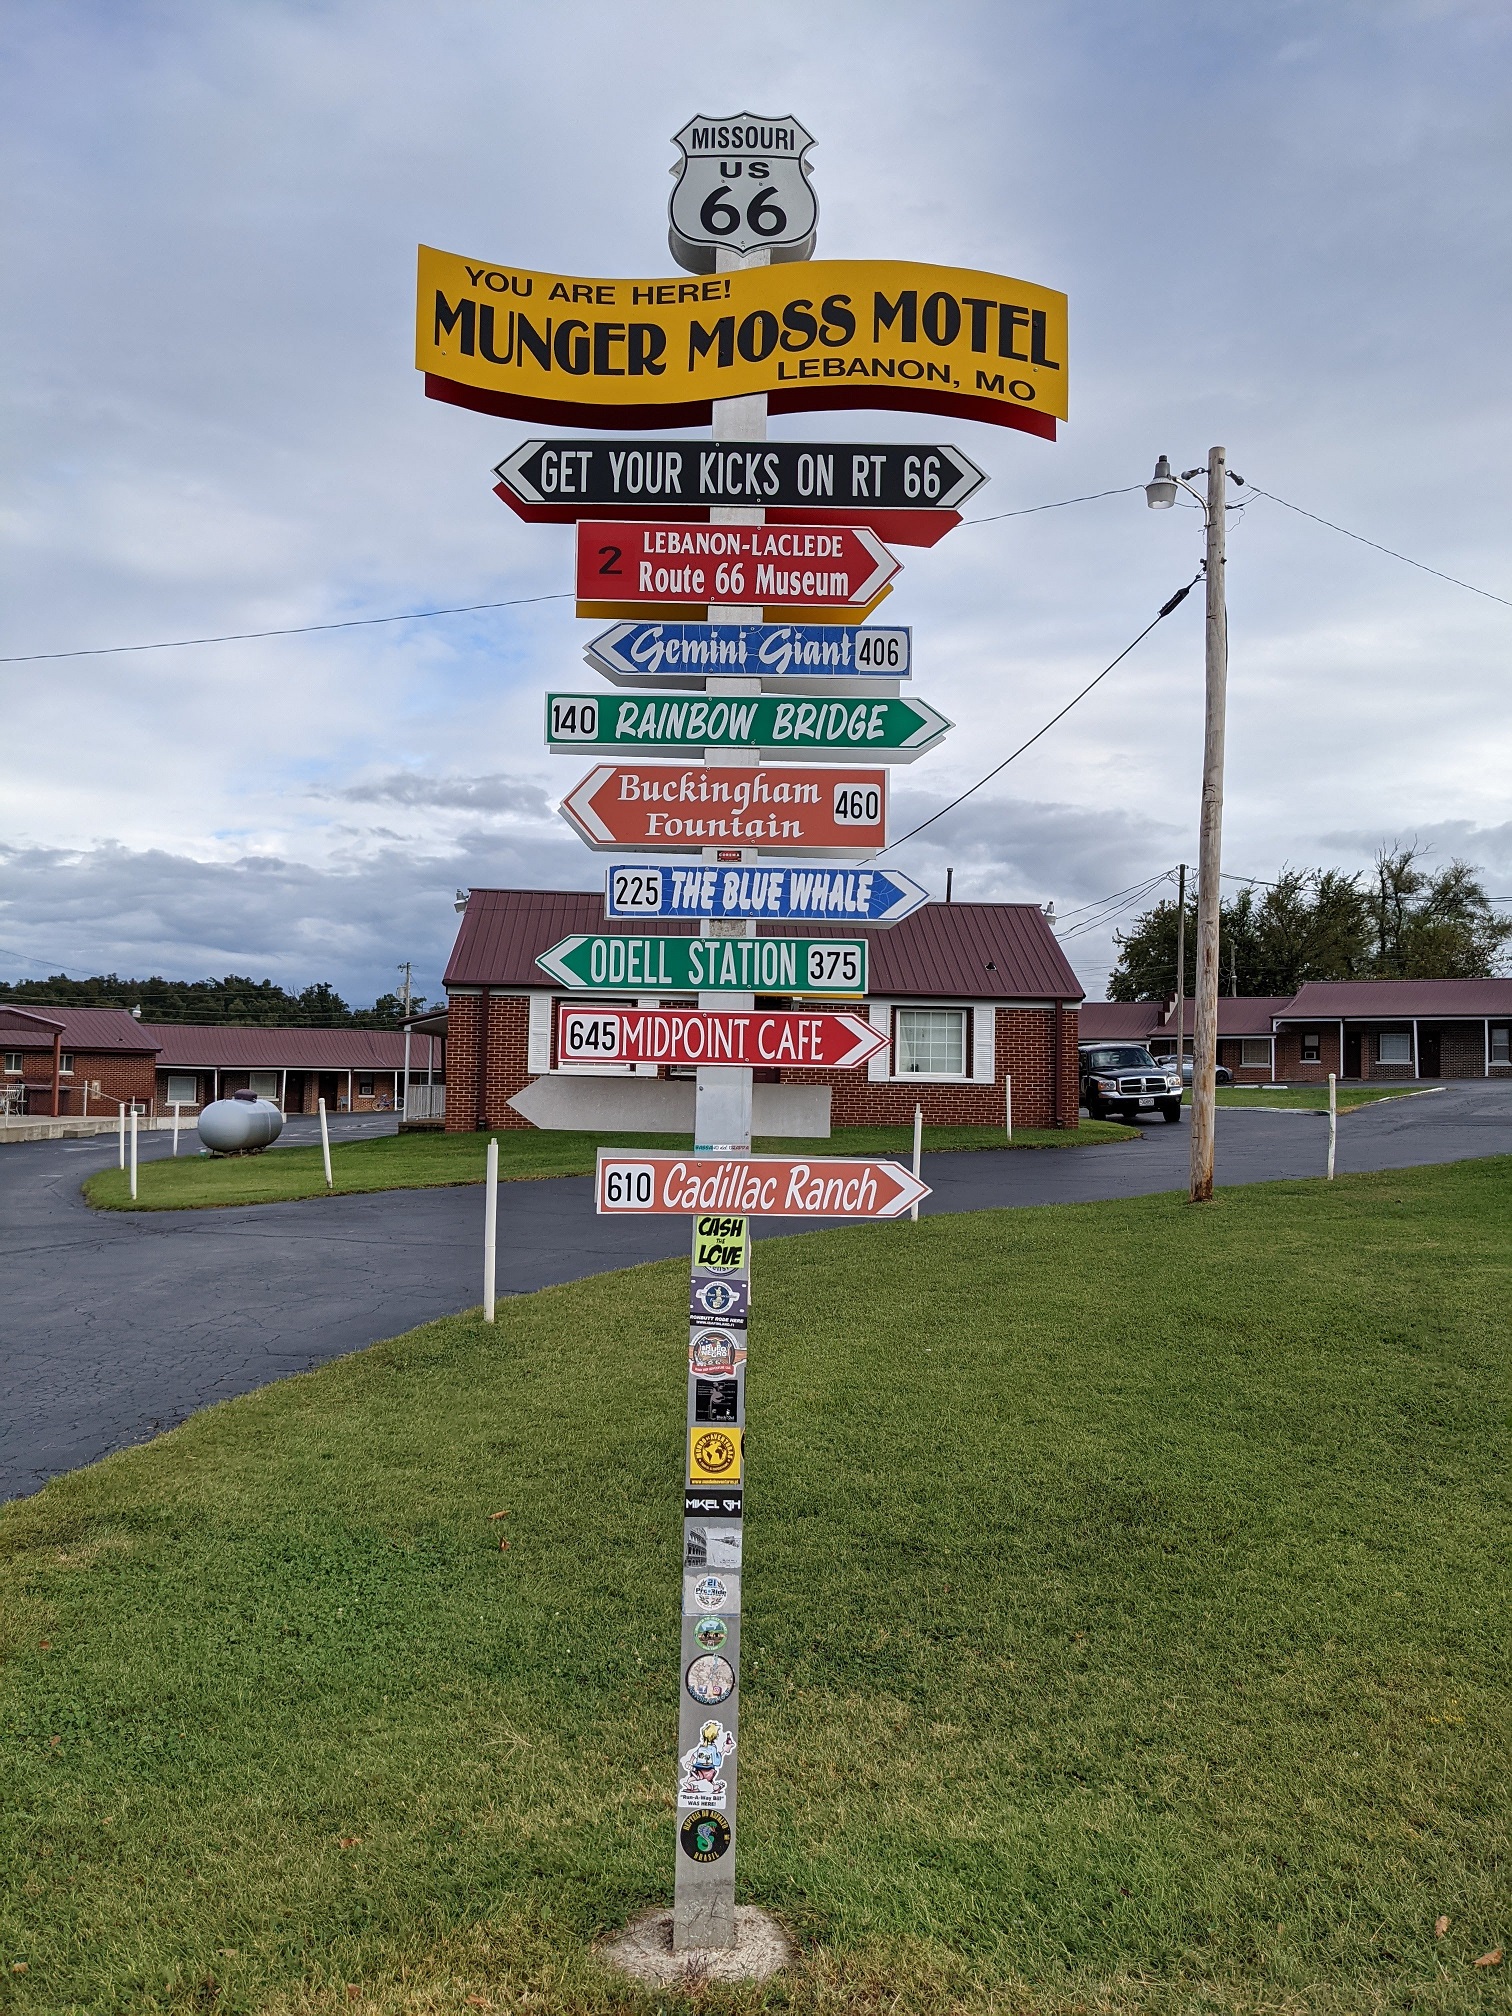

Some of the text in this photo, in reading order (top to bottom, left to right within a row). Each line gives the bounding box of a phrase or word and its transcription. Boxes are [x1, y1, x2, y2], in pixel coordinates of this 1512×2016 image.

[691, 125, 796, 151] MISSOURI
[720, 161, 770, 179] US
[700, 186, 787, 236] 66
[464, 266, 731, 306] YOU ARE HERE!
[435, 290, 1059, 376] MUNGER MOSS MOTEL
[777, 358, 1036, 402] LEBANON, MO
[541, 451, 941, 499] GET YOUR KICKS ON RT 66
[597, 546, 623, 575] 2
[643, 531, 843, 558] LEBANON-LACLEDE
[638, 561, 849, 597] Route 66 Museum
[630, 627, 853, 674] Gemini Giant
[859, 637, 898, 666] 406
[553, 703, 596, 734] 140
[615, 701, 888, 741] RAINBOW BRIDGE
[617, 772, 822, 816] Buckingham
[836, 790, 879, 820] 460
[645, 812, 804, 838] Fountain
[616, 877, 658, 907] 225
[671, 870, 873, 912] THE BLUE WHALE
[591, 939, 796, 986] ODELL STATION
[810, 951, 857, 980] 375
[570, 1020, 616, 1051] 645
[621, 1016, 823, 1061] MIDPOINT CAFE
[607, 1171, 651, 1203] 610
[663, 1162, 878, 1211] Cadillac Ranch
[698, 1217, 743, 1237] CASH
[698, 1244, 743, 1265] LOVE
